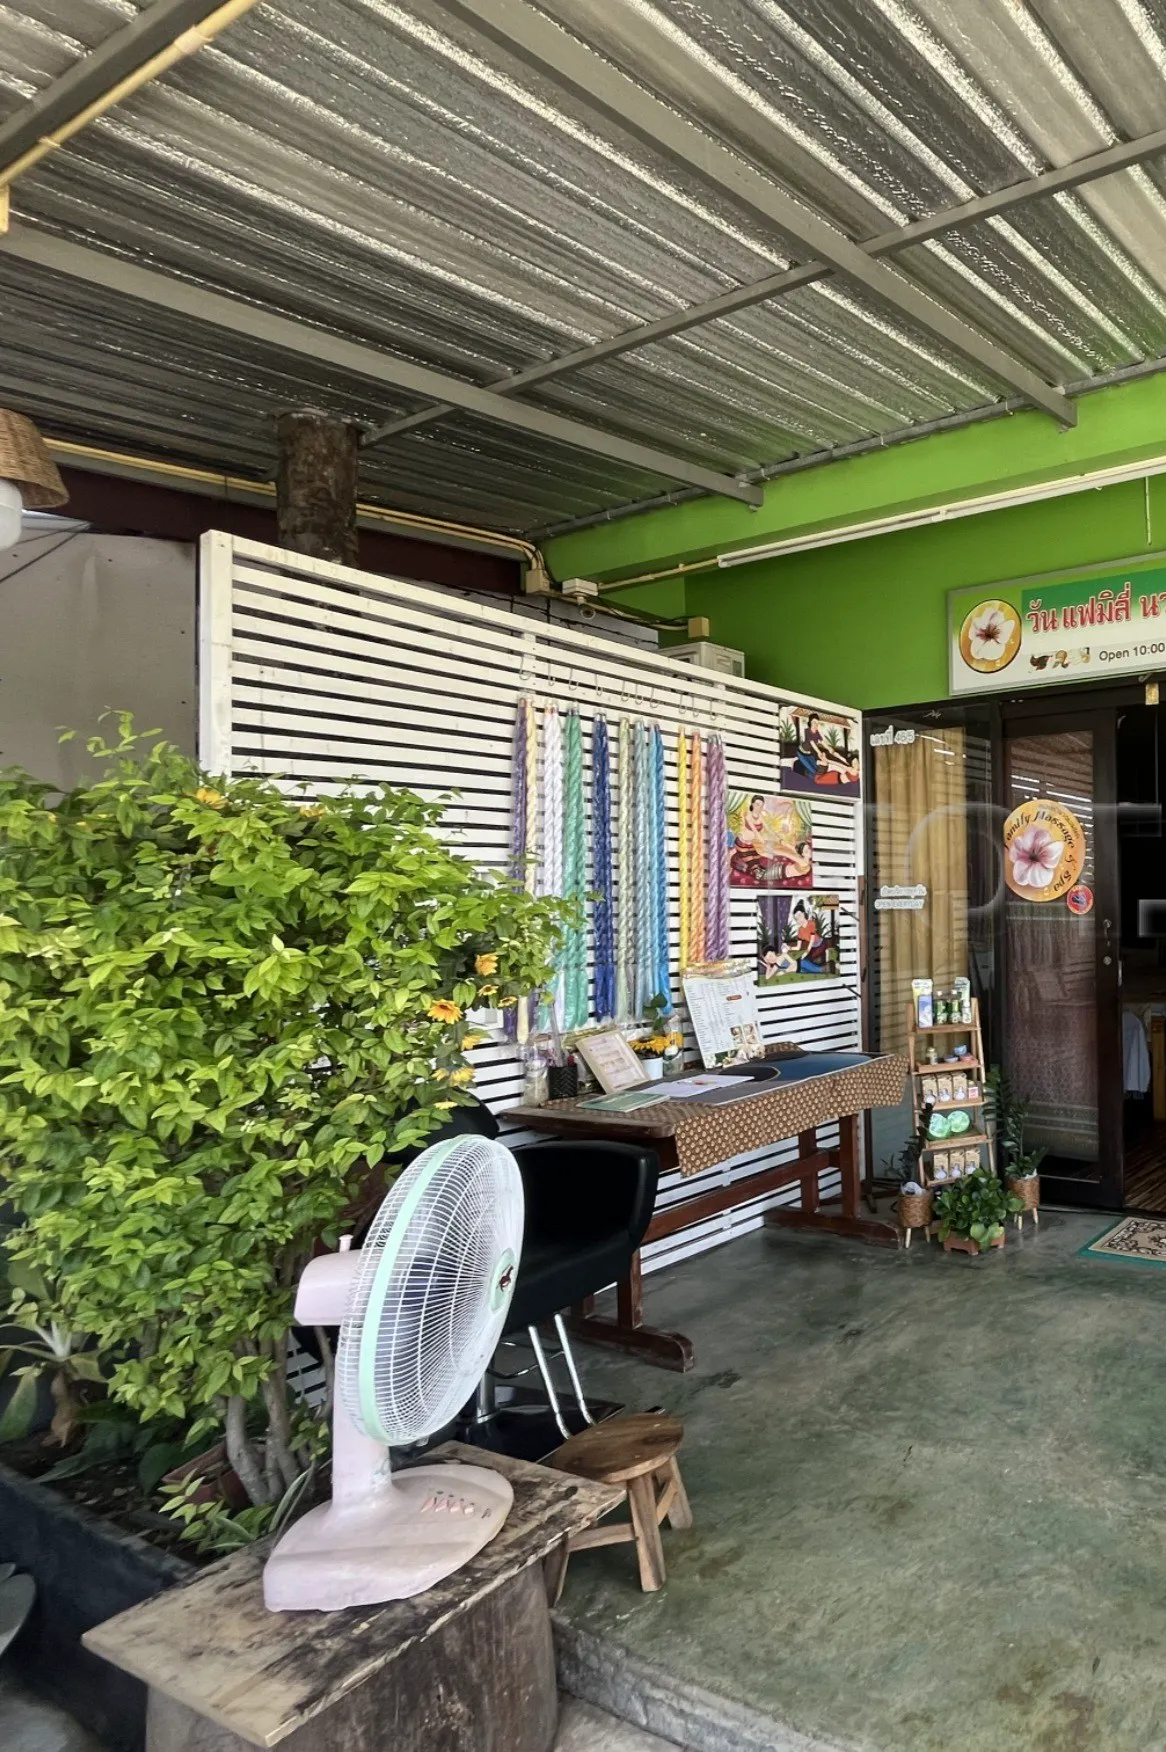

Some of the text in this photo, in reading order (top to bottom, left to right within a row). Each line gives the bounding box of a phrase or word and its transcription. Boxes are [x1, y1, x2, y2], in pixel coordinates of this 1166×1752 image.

[1098, 649, 1130, 661] Open
[1133, 642, 1166, 657] 10:00
[1054, 870, 1072, 892] Spa
